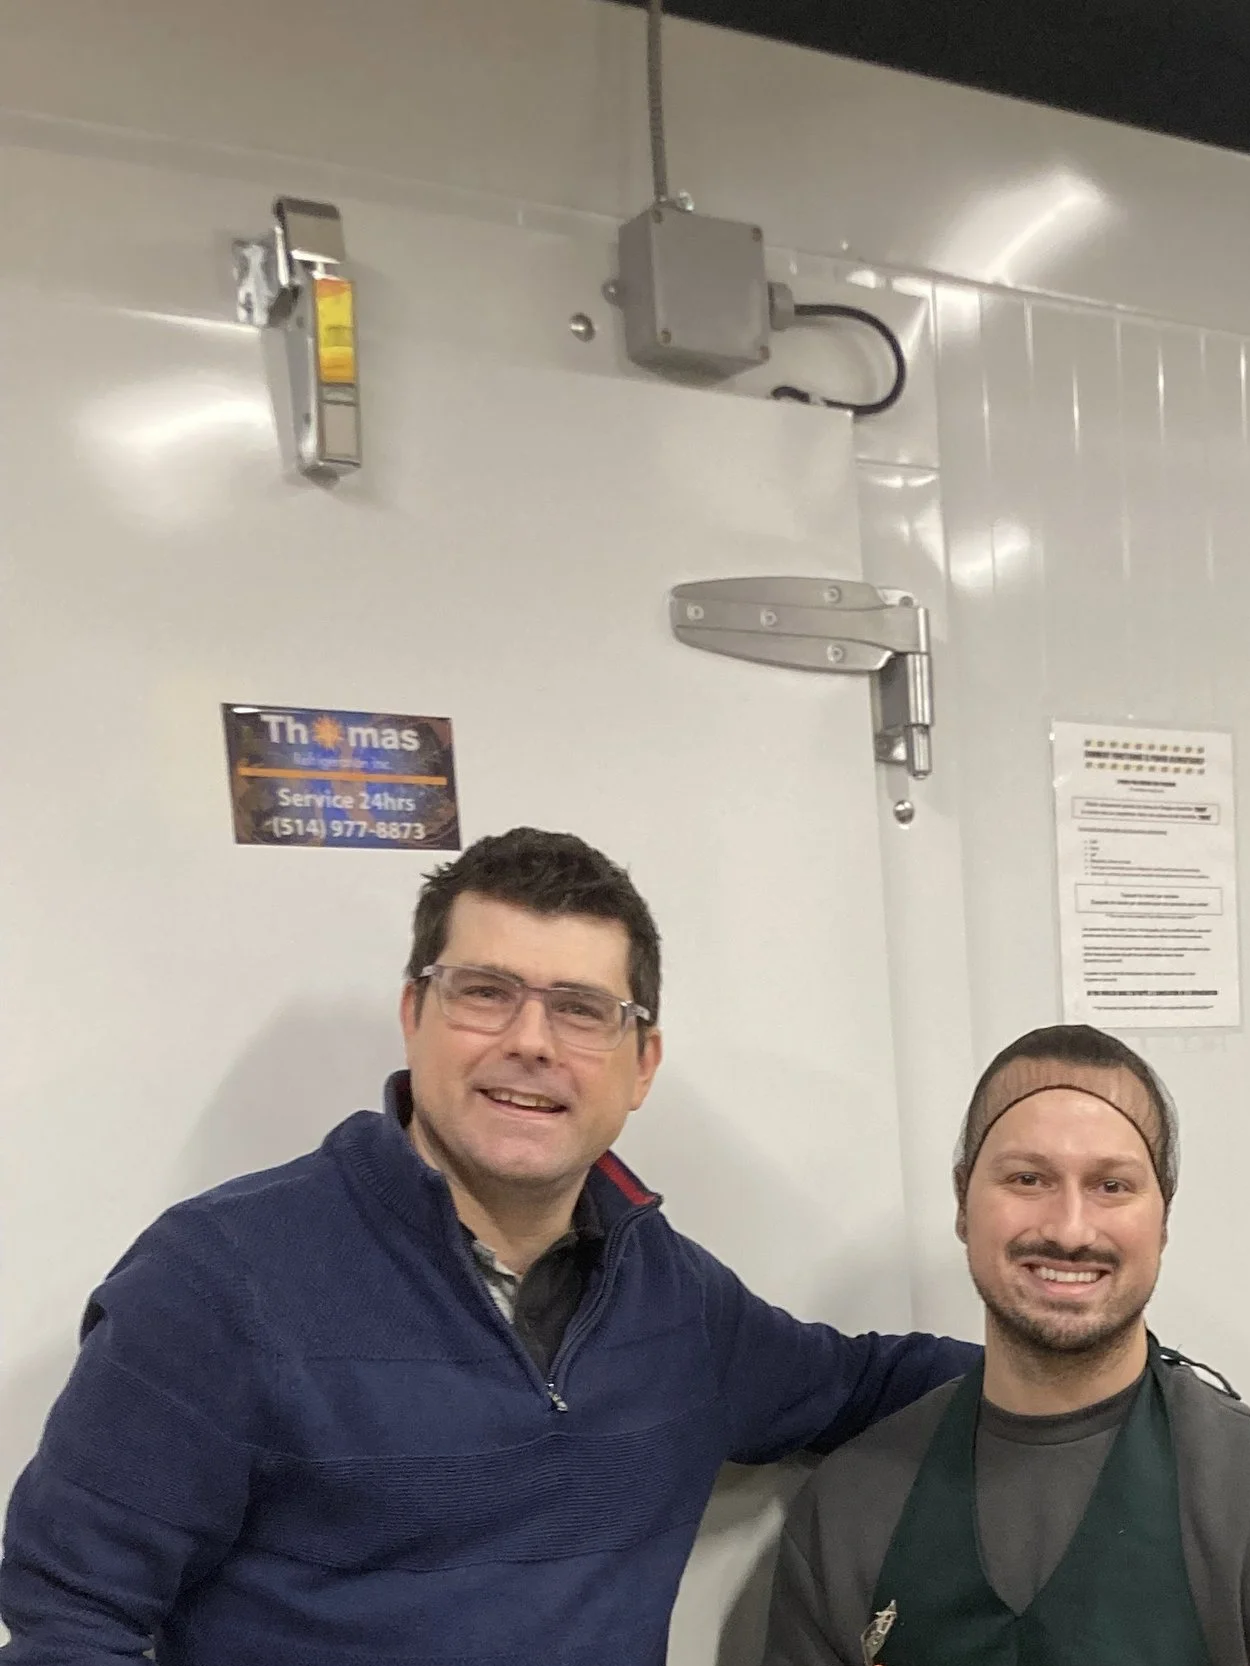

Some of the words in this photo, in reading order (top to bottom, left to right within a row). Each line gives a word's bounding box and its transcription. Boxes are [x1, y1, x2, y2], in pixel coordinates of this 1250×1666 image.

[276, 788, 355, 810] Service
[358, 792, 417, 812] 24hrs
[271, 816, 327, 840] (514)
